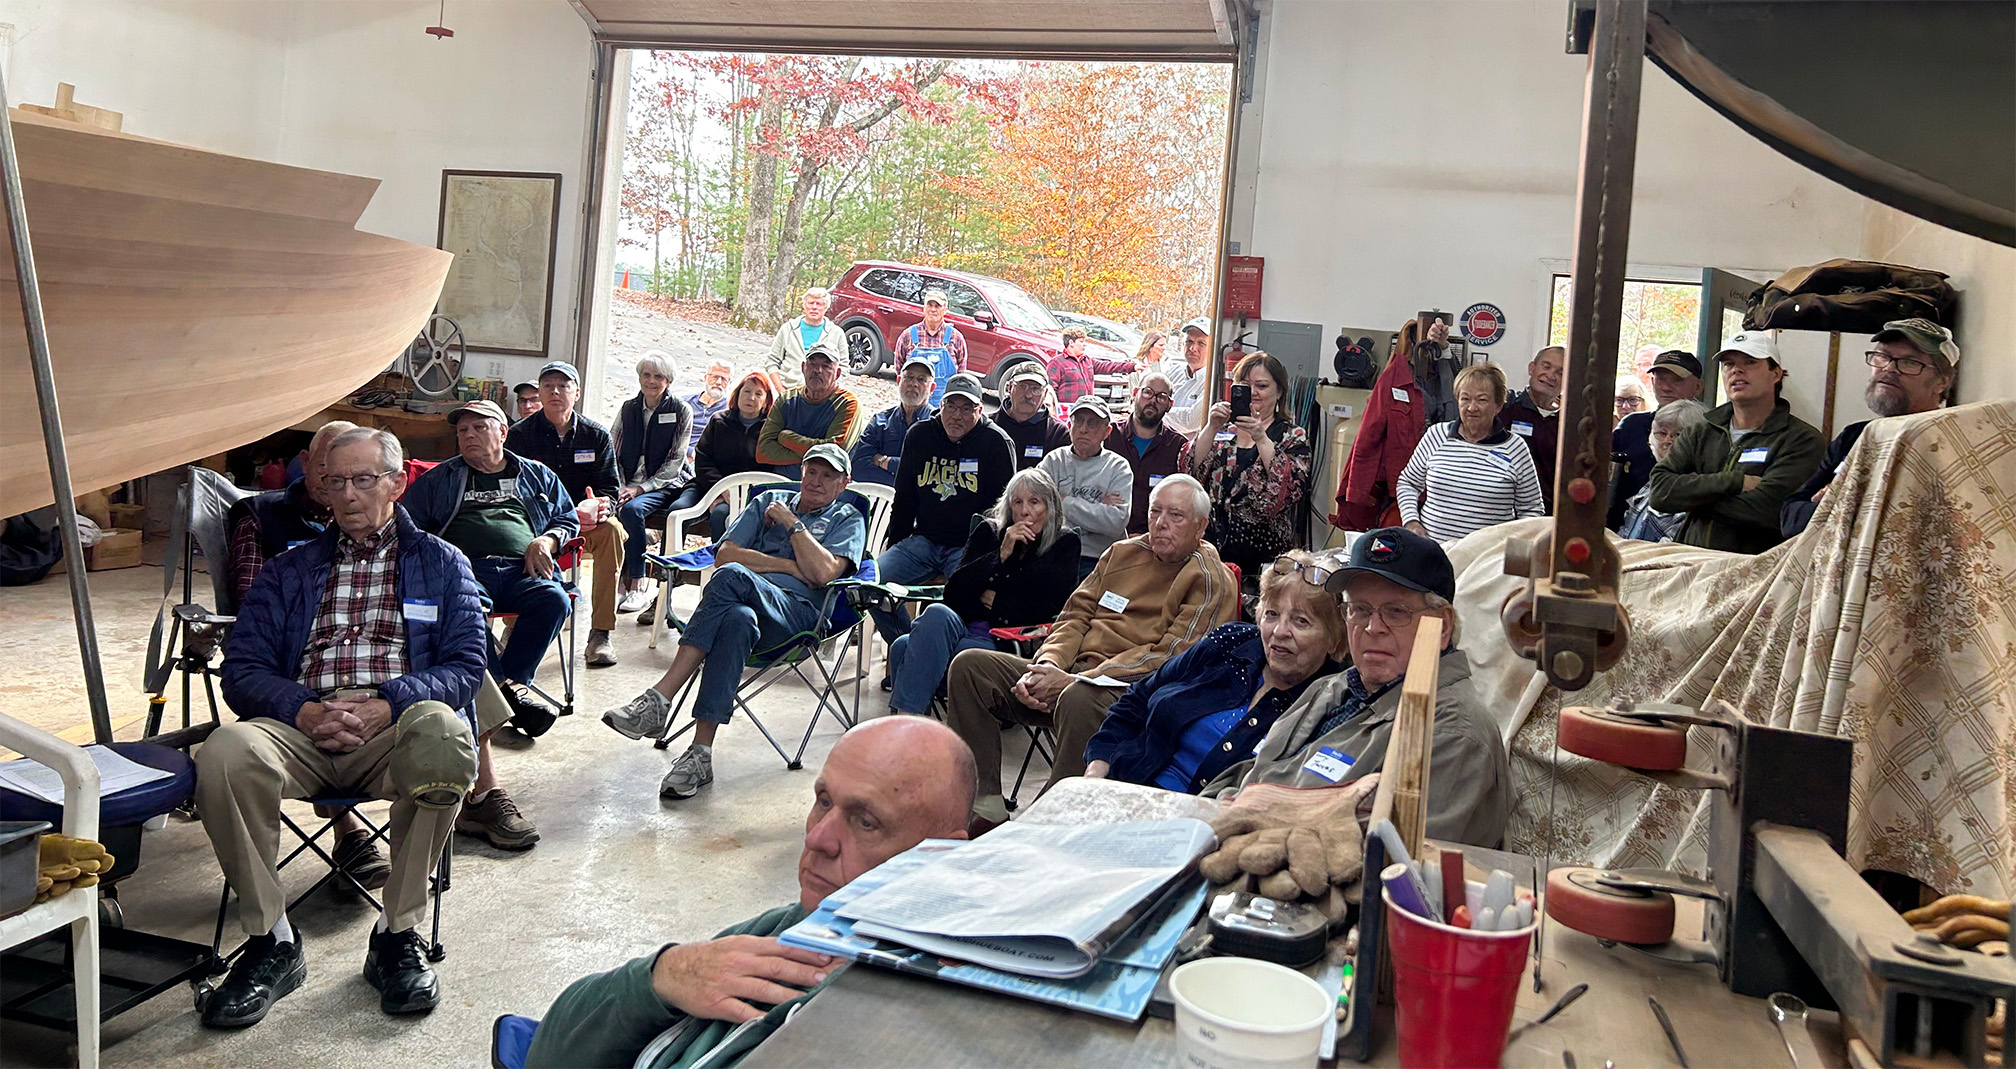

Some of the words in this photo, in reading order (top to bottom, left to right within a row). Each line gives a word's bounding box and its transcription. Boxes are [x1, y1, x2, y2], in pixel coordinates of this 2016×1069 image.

[1466, 304, 1501, 317] AUTHORIZED
[1466, 333, 1498, 345] SERVICE
[917, 461, 978, 493] JACKS
[1199, 1027, 1215, 1040] NO
